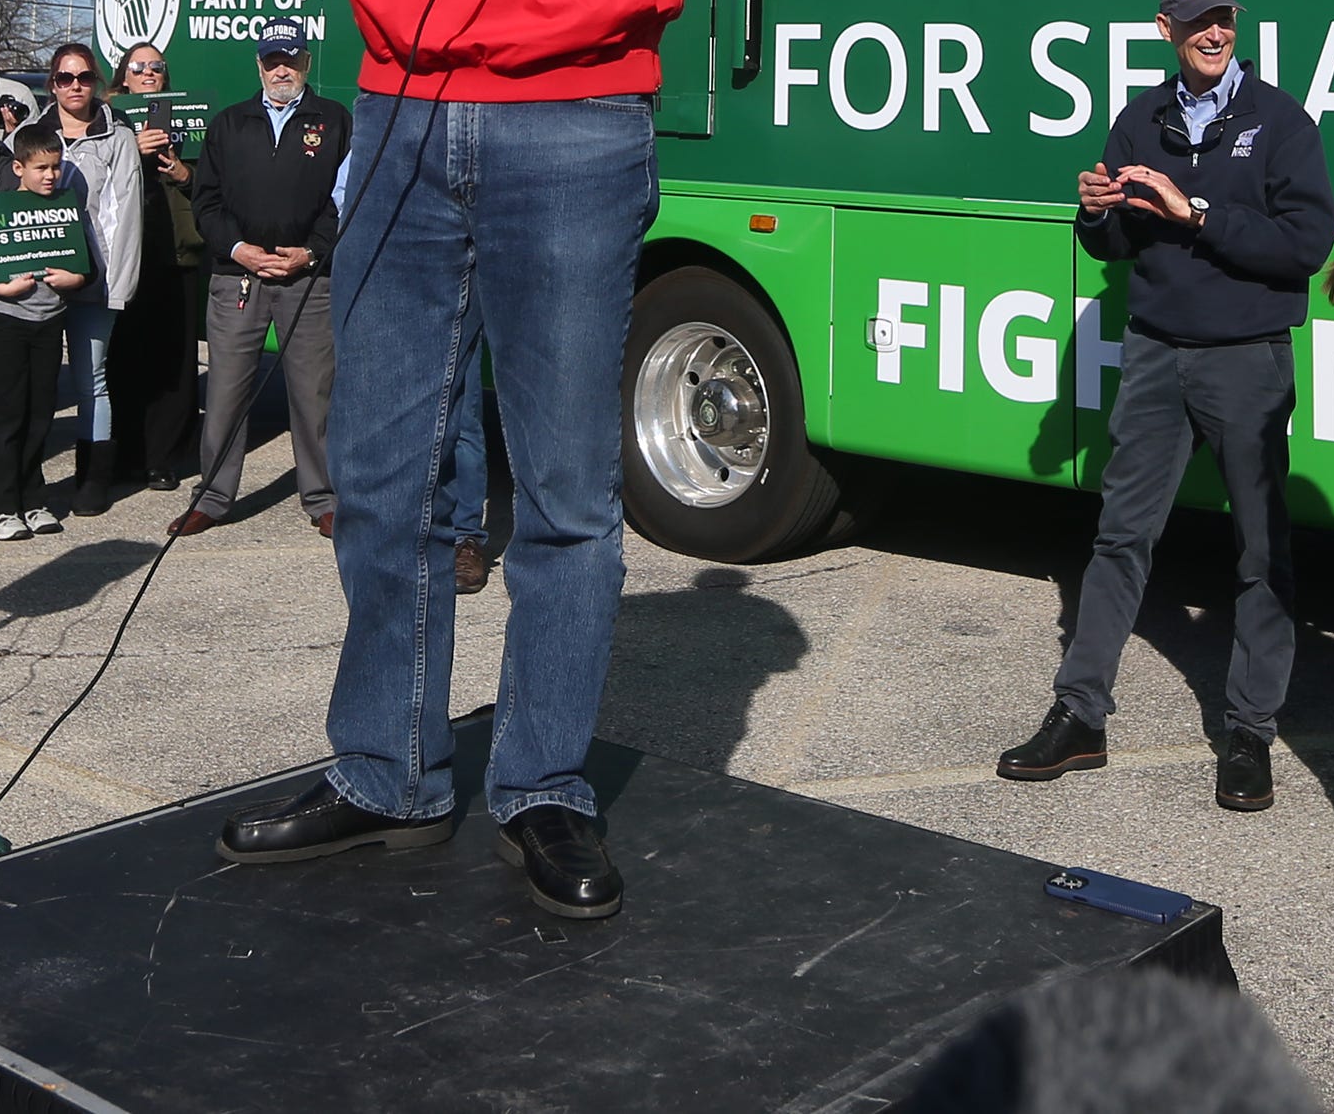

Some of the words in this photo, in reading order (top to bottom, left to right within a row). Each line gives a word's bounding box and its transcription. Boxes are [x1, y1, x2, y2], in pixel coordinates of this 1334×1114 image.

[274, 24, 298, 37] FORCE
[773, 22, 992, 135] FOR
[8, 208, 79, 227] JOHNSON
[13, 227, 66, 242] SENATE
